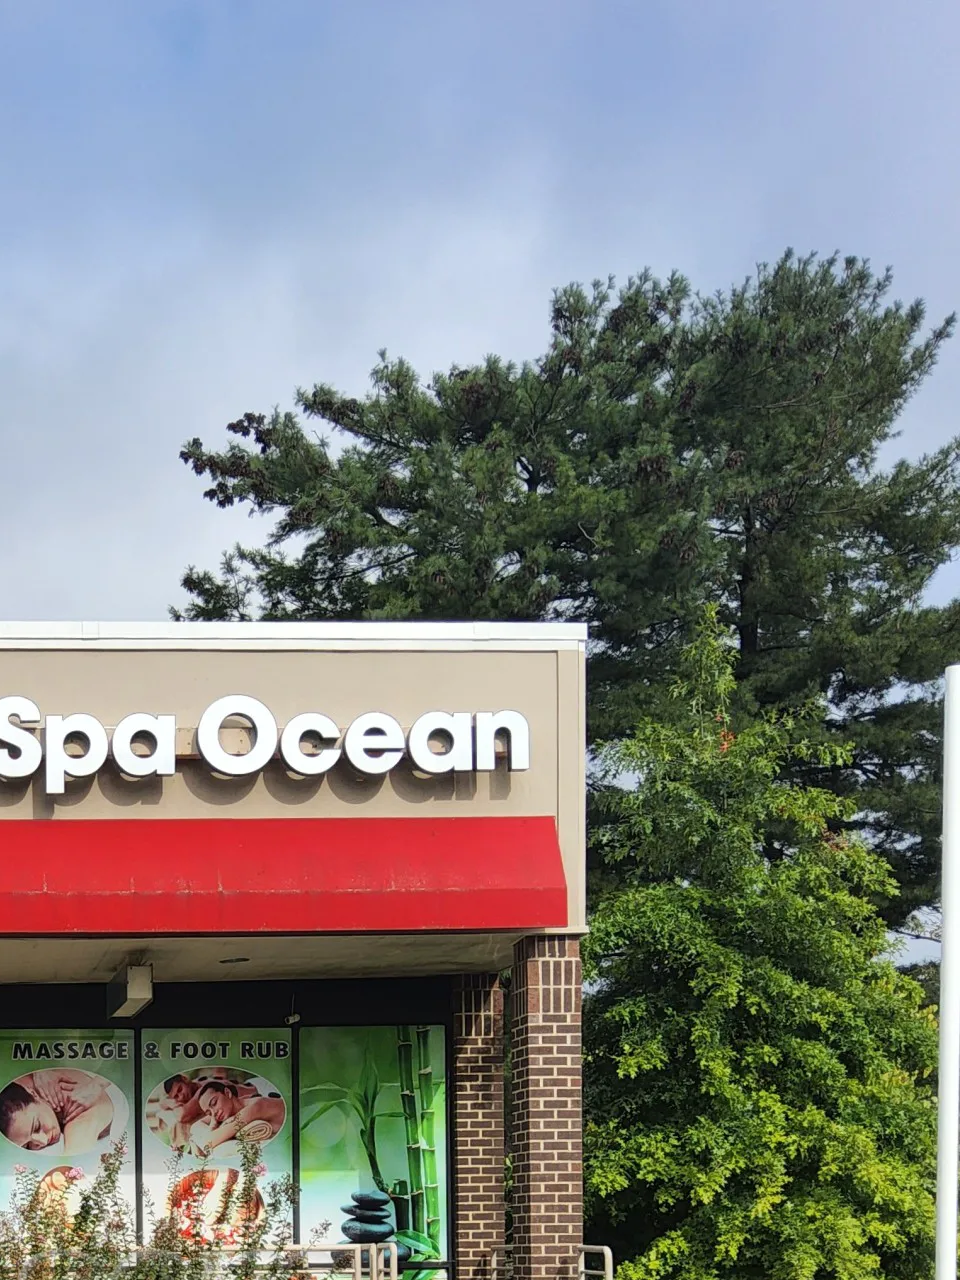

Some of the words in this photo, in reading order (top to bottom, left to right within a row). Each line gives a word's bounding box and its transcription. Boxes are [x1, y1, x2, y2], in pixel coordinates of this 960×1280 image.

[197, 693, 531, 778] Ocean
[12, 1041, 130, 1061] MASSAGE
[144, 1042, 161, 1061] &
[170, 1041, 231, 1060] FOOT
[240, 1041, 289, 1060] RUB
